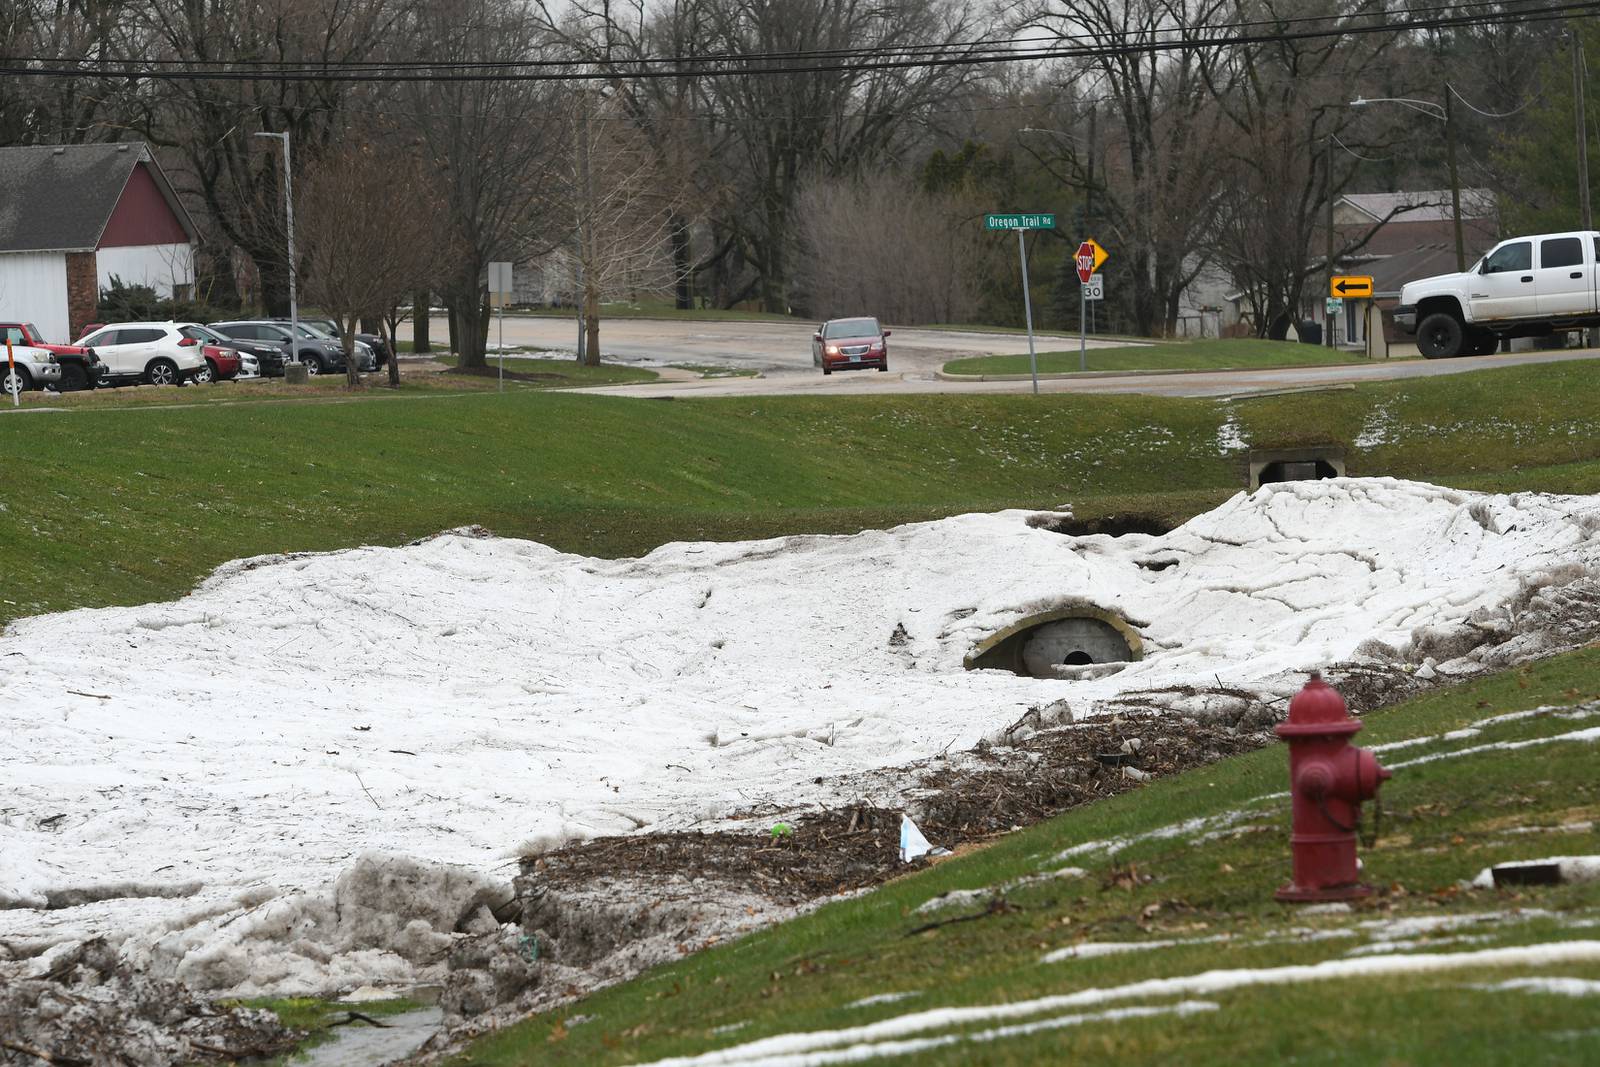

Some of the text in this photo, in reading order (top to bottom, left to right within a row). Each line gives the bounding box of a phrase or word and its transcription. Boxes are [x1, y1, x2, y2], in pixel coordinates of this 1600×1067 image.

[990, 216, 1051, 228] Oregon Trail Rd
[1078, 256, 1093, 270] STOP
[1085, 288, 1101, 297] 30
